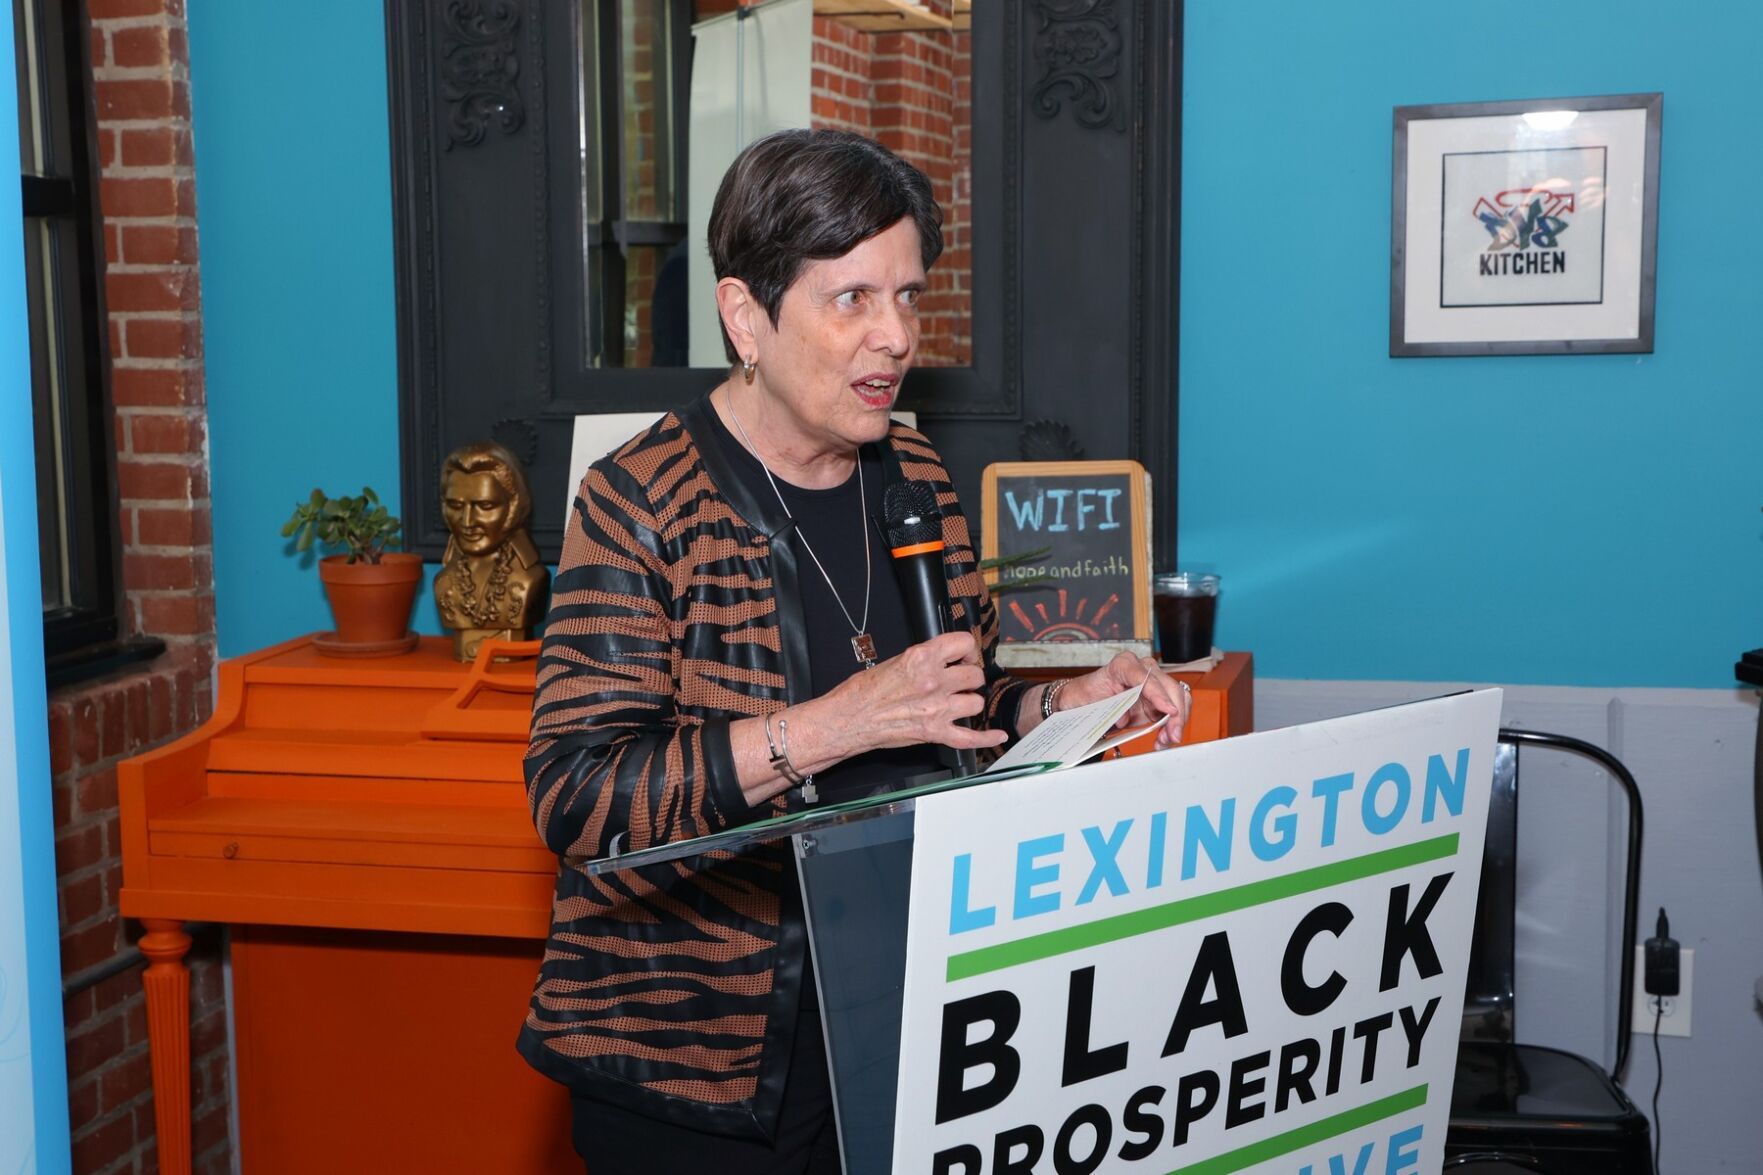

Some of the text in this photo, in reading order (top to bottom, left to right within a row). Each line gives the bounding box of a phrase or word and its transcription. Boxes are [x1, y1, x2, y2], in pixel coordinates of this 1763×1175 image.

[1479, 251, 1565, 276] KITCHEN
[1005, 488, 1122, 532] WIFI
[948, 748, 1471, 936] LEXINGTON
[935, 871, 1456, 1126] BLACK
